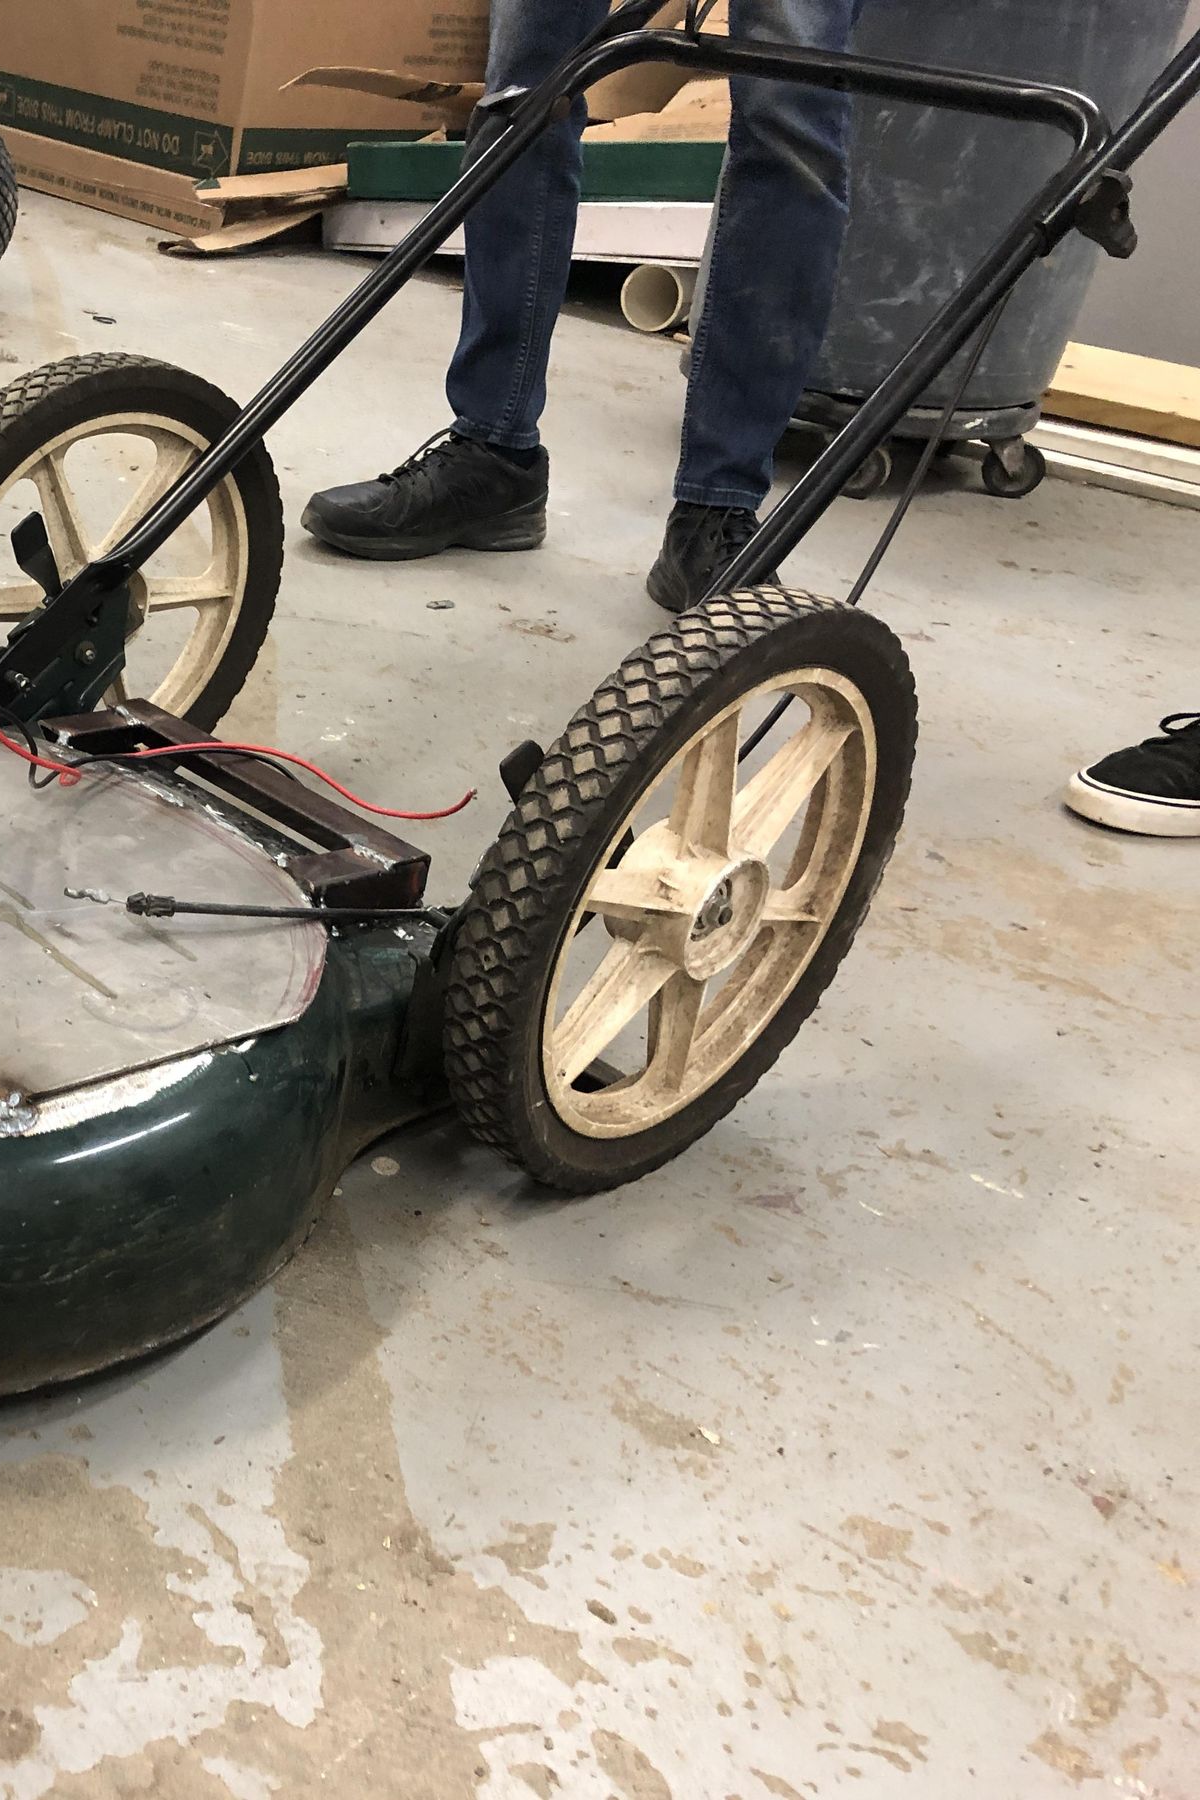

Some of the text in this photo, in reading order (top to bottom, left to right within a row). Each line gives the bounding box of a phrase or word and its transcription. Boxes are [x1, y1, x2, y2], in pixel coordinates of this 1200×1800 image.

[16, 95, 180, 155] DO NOT CLAMP FROM THIS SIDE
[246, 151, 273, 164] SIDE
